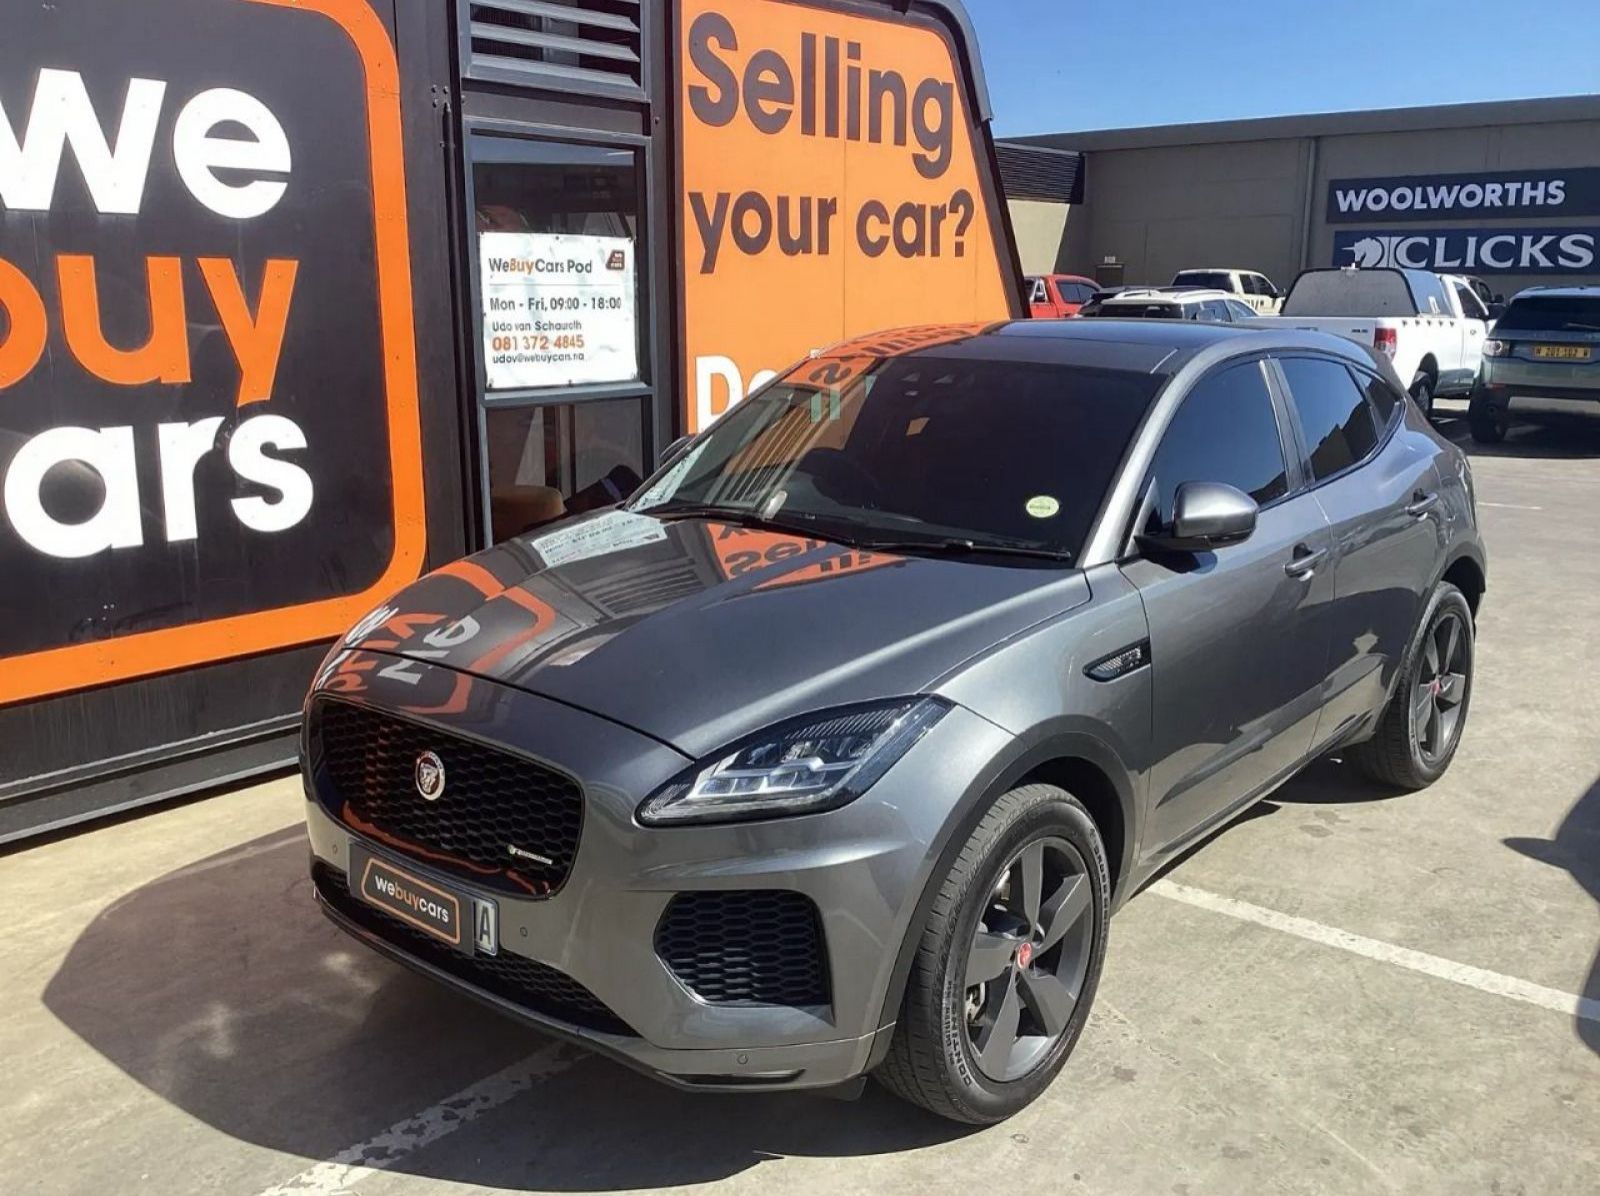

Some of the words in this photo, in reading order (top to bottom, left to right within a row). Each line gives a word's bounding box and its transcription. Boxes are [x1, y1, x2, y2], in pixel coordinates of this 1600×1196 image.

[688, 11, 954, 179] Selling
[1335, 180, 1566, 213] WOOLWORTHS
[688, 191, 837, 274] your
[856, 188, 975, 258] car?
[489, 258, 565, 275] WeBuyCars
[567, 259, 593, 274] Pod
[1395, 233, 1595, 269] CLICKS
[490, 297, 516, 311] Mon
[528, 297, 548, 312] Fri,
[550, 297, 580, 311] 09:00
[591, 297, 622, 310] 18:00
[492, 335, 518, 351] 081
[523, 334, 550, 350] 372
[554, 334, 585, 349] 4845
[515, 323, 531, 332] van
[374, 874, 450, 924] webuycars
[479, 905, 492, 945] A
